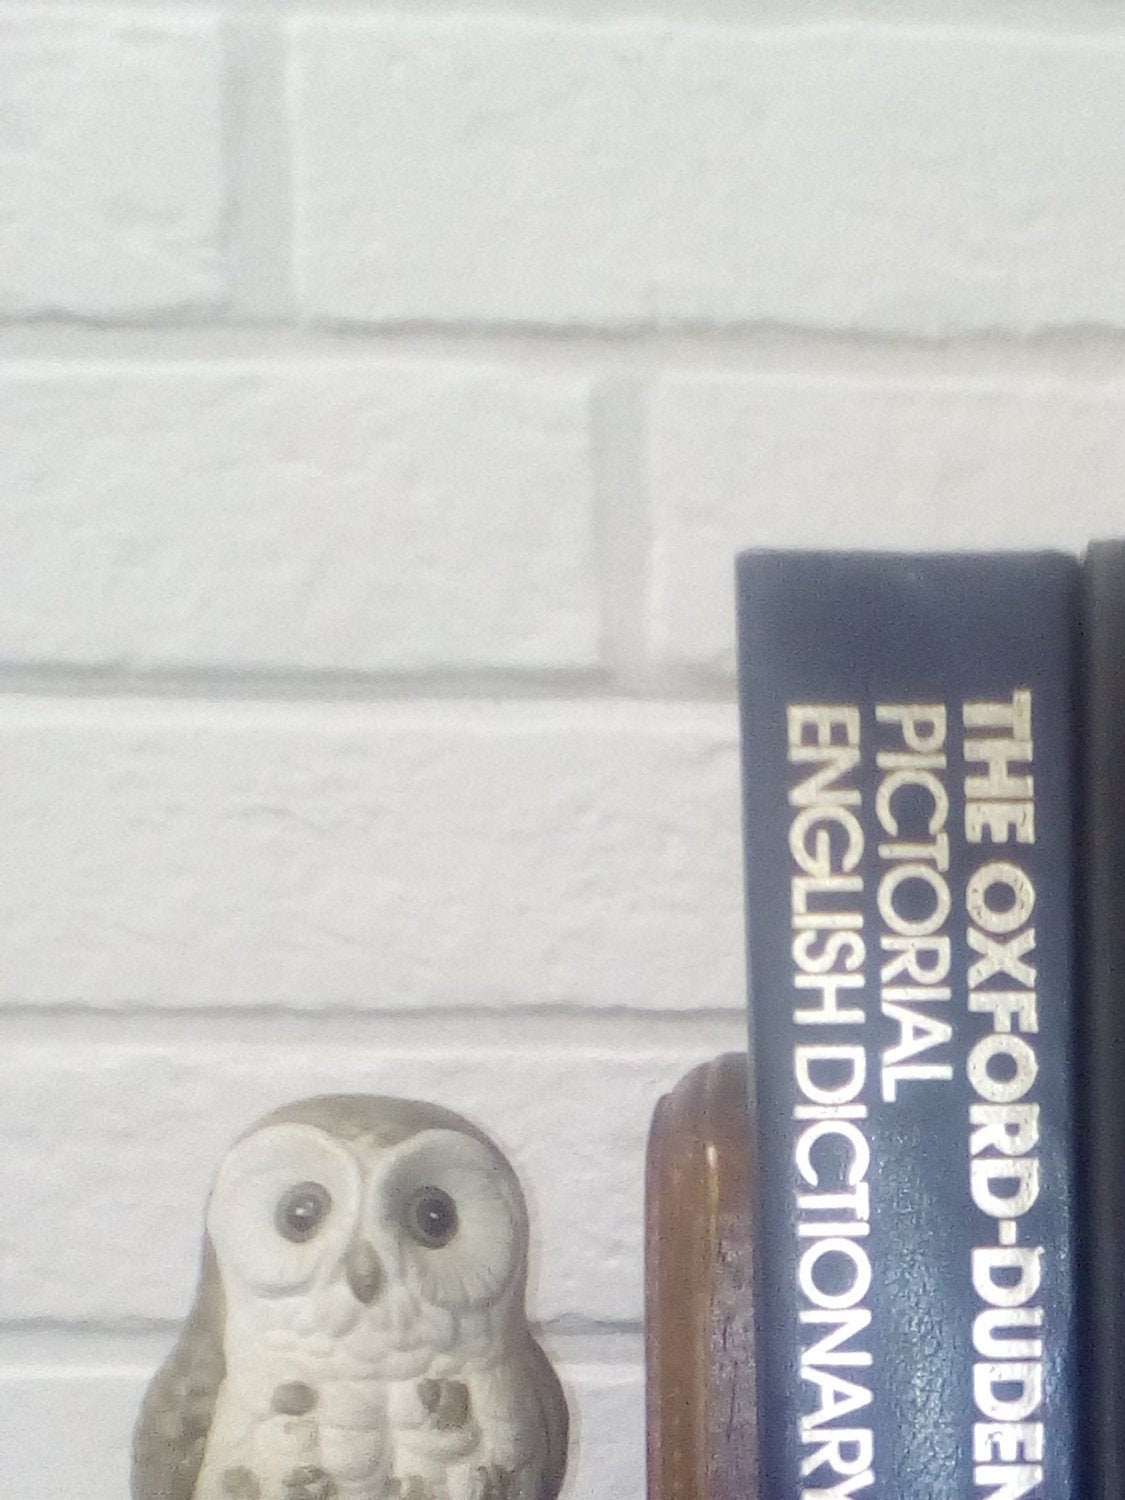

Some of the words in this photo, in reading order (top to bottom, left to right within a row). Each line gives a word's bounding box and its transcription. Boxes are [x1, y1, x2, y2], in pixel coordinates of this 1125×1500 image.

[786, 704, 867, 1025] ENGLISH
[875, 703, 954, 1104] PICTORIAL
[962, 688, 1036, 845] THE
